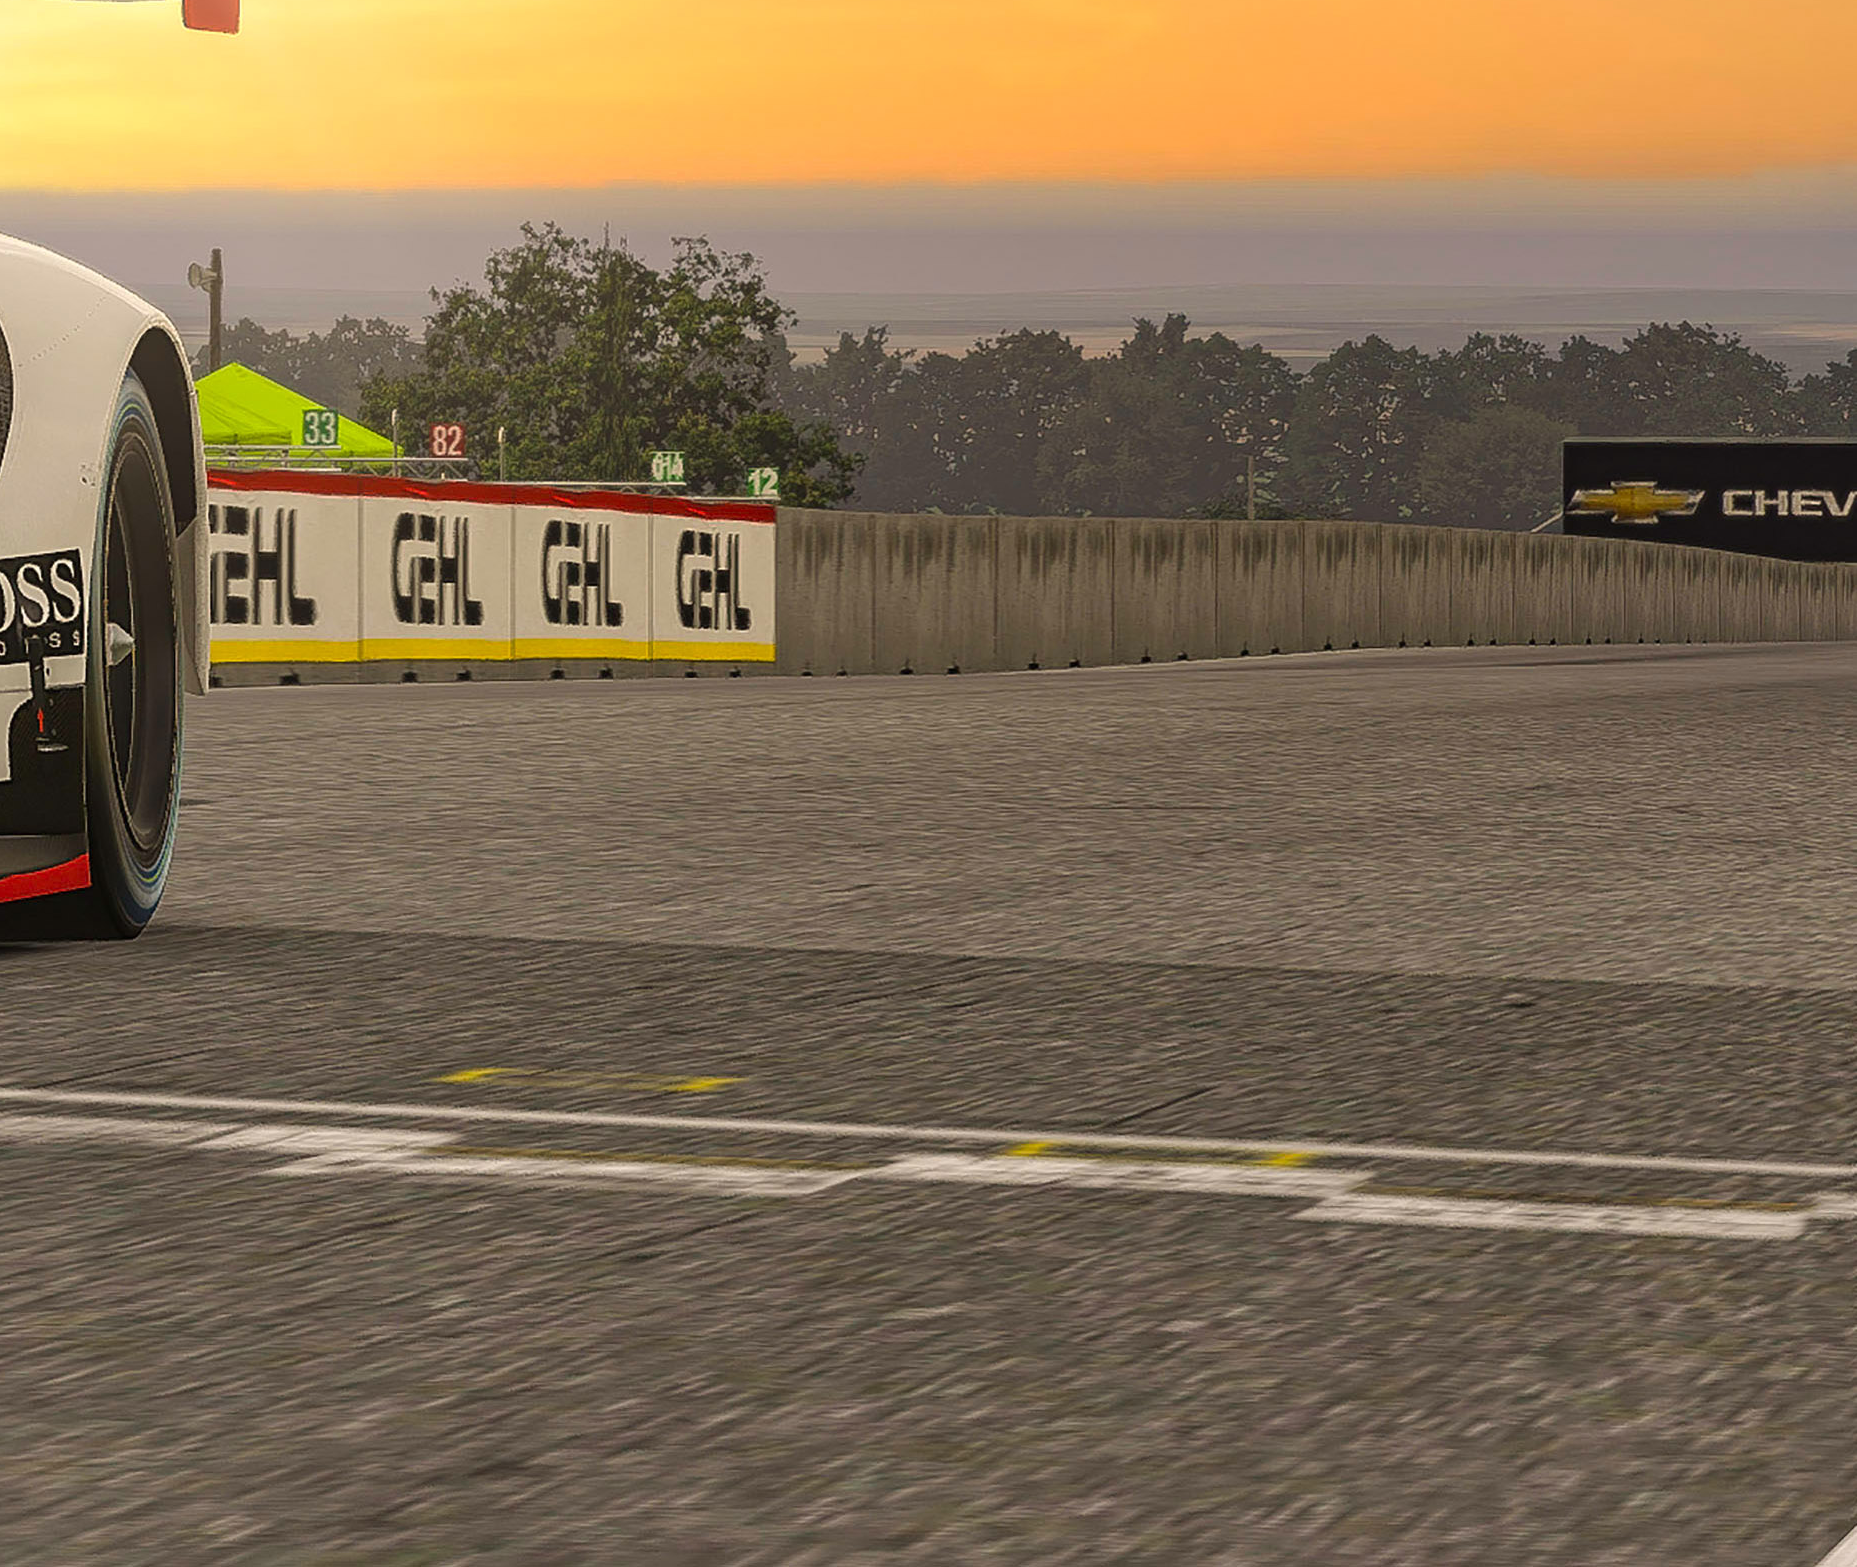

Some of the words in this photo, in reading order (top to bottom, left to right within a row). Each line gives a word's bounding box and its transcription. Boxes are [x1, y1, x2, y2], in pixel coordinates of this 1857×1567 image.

[304, 410, 337, 446] 33
[432, 424, 463, 458] 82
[748, 467, 779, 496] 12
[1722, 490, 1857, 517] CHEV
[209, 504, 318, 626] EHL
[391, 512, 484, 625] GEHL
[541, 520, 623, 627] GEHL
[676, 529, 752, 631] GEHL
[23, 629, 81, 655] SS
